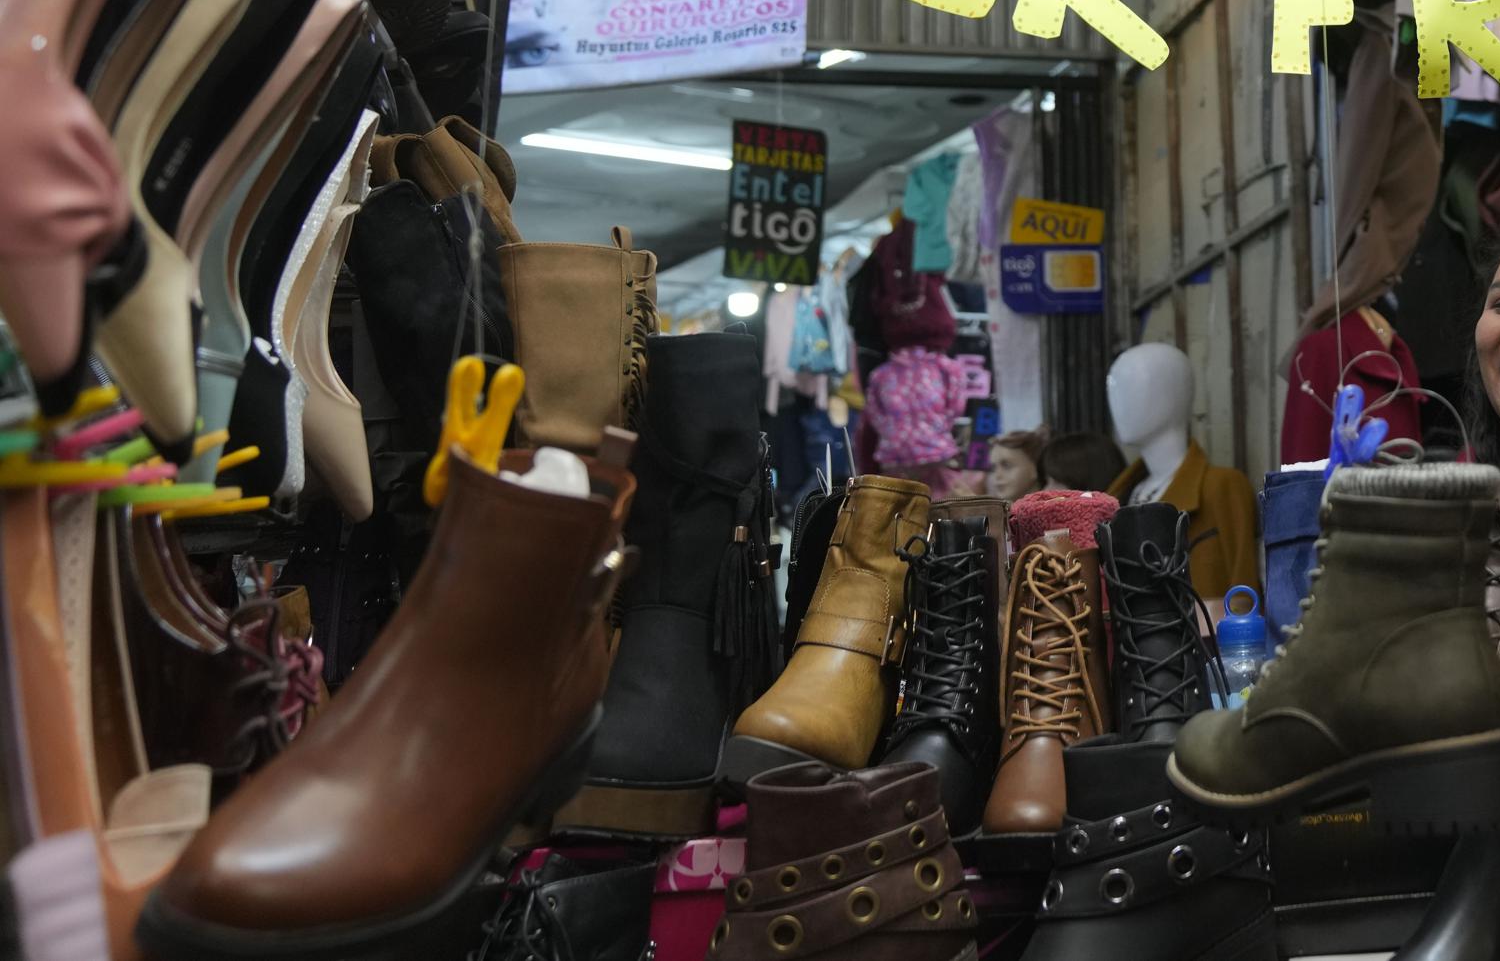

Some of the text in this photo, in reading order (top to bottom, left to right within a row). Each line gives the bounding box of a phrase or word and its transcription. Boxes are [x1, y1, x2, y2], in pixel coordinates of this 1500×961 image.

[594, 0, 789, 36] QUIRURGICOS
[609, 3, 666, 20] CON
[576, 39, 650, 56] Huyustus
[712, 23, 767, 44] Rosario
[734, 142, 825, 173] TARJETAS
[733, 165, 823, 207] Entel
[731, 203, 816, 255] tigo
